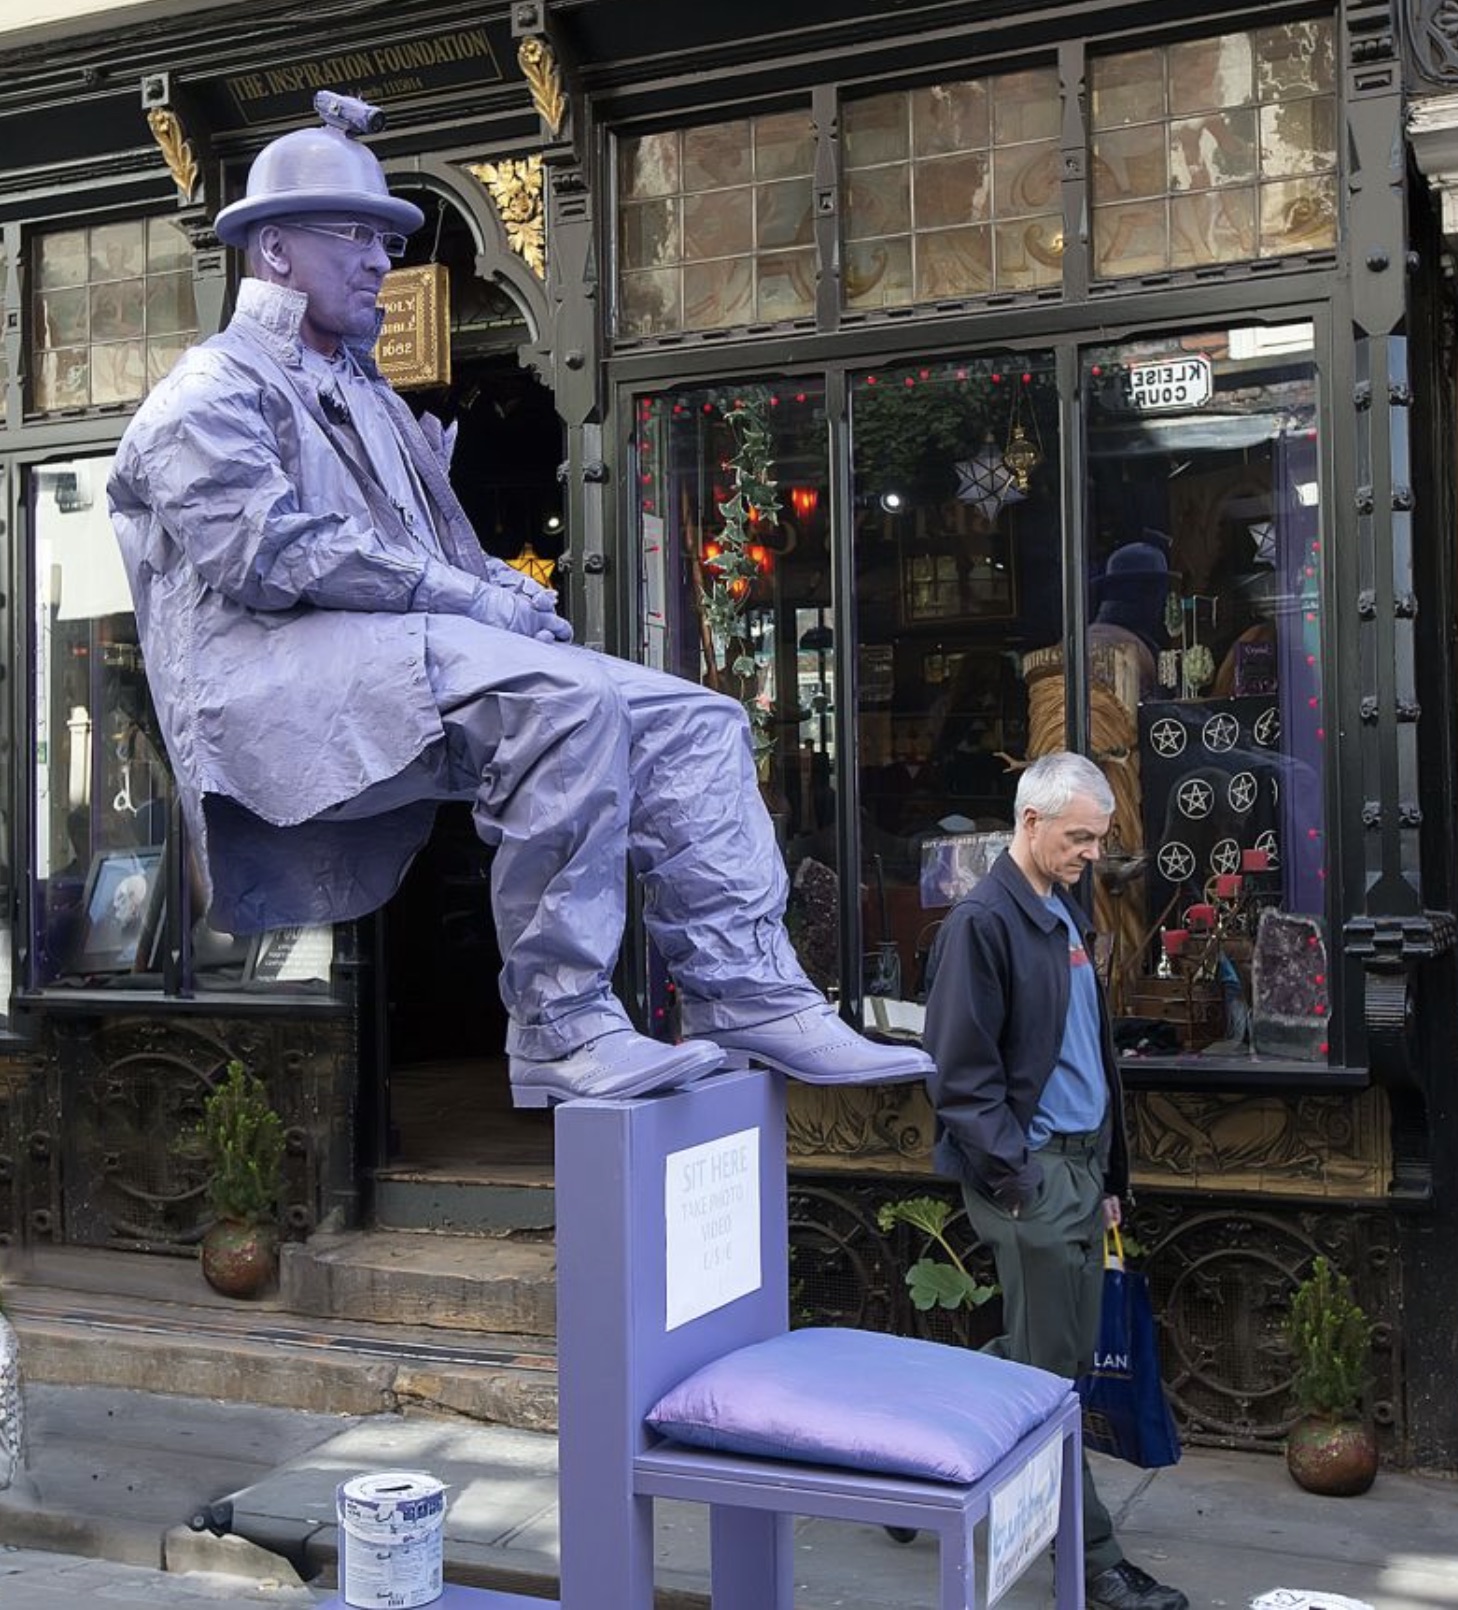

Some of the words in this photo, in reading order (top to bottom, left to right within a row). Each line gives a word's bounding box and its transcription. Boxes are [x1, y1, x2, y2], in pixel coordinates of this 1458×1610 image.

[233, 74, 270, 101] THE
[264, 52, 376, 96] INSPIRATION
[373, 28, 489, 75] FOUNDATION
[382, 339, 413, 357] 1682
[681, 1158, 707, 1193] SIT
[711, 1145, 747, 1183] HERE
